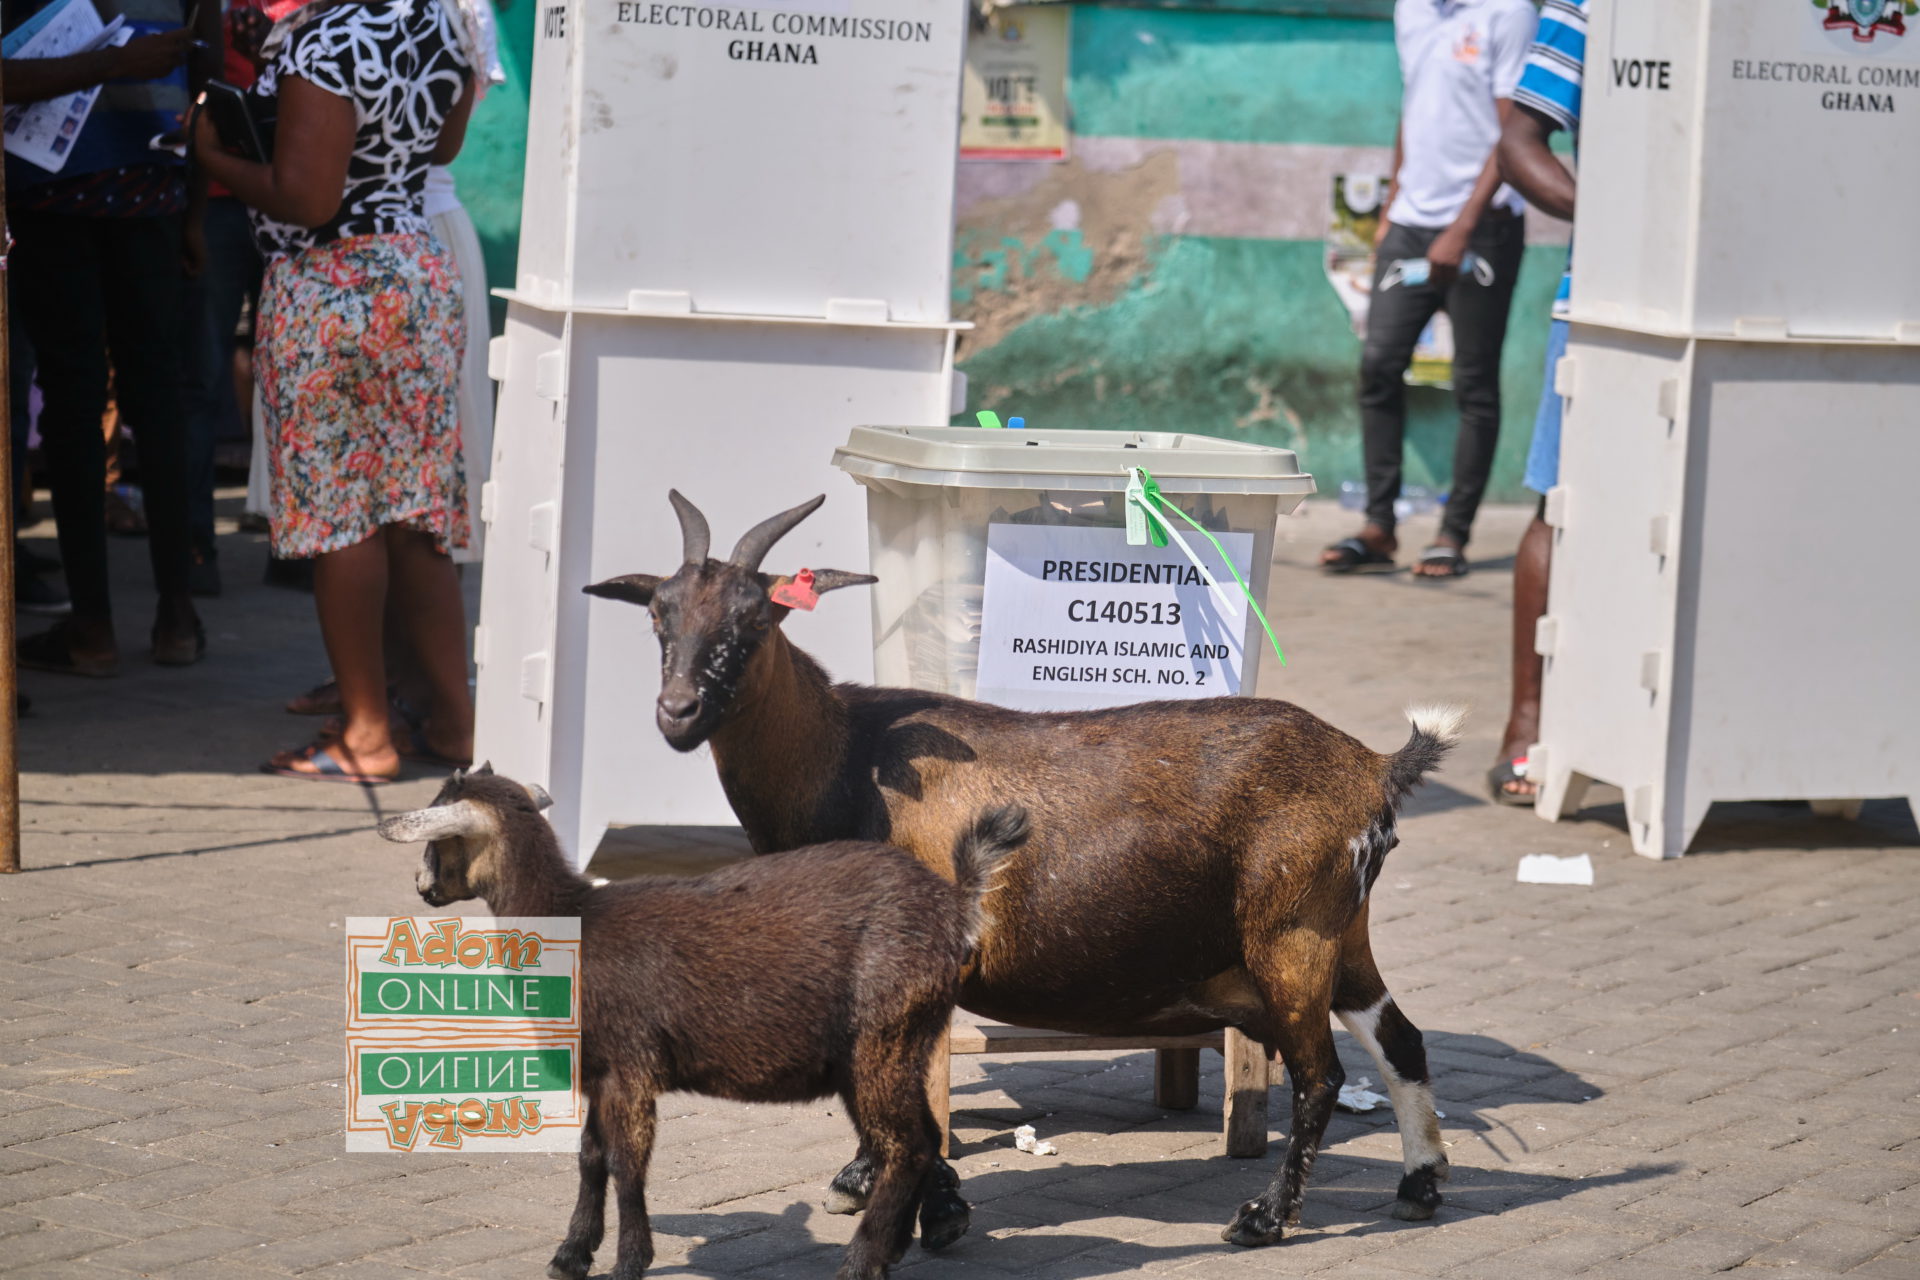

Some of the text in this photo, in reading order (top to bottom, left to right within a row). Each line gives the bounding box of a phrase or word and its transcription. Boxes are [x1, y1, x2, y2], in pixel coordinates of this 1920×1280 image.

[544, 6, 565, 38] VOTE
[617, 1, 932, 43] ELECTORAL COMMISSION
[728, 39, 818, 65] GHANA
[1612, 58, 1671, 90] VOTE
[1732, 59, 1920, 89] ELECTORAL COMM
[1821, 91, 1895, 114] GHANA
[1067, 599, 1182, 625] C140513
[1012, 637, 1230, 660] RASHIDIYA ISLAMIC AND
[1032, 665, 1205, 686] ENGLISH SCH. NO. 2
